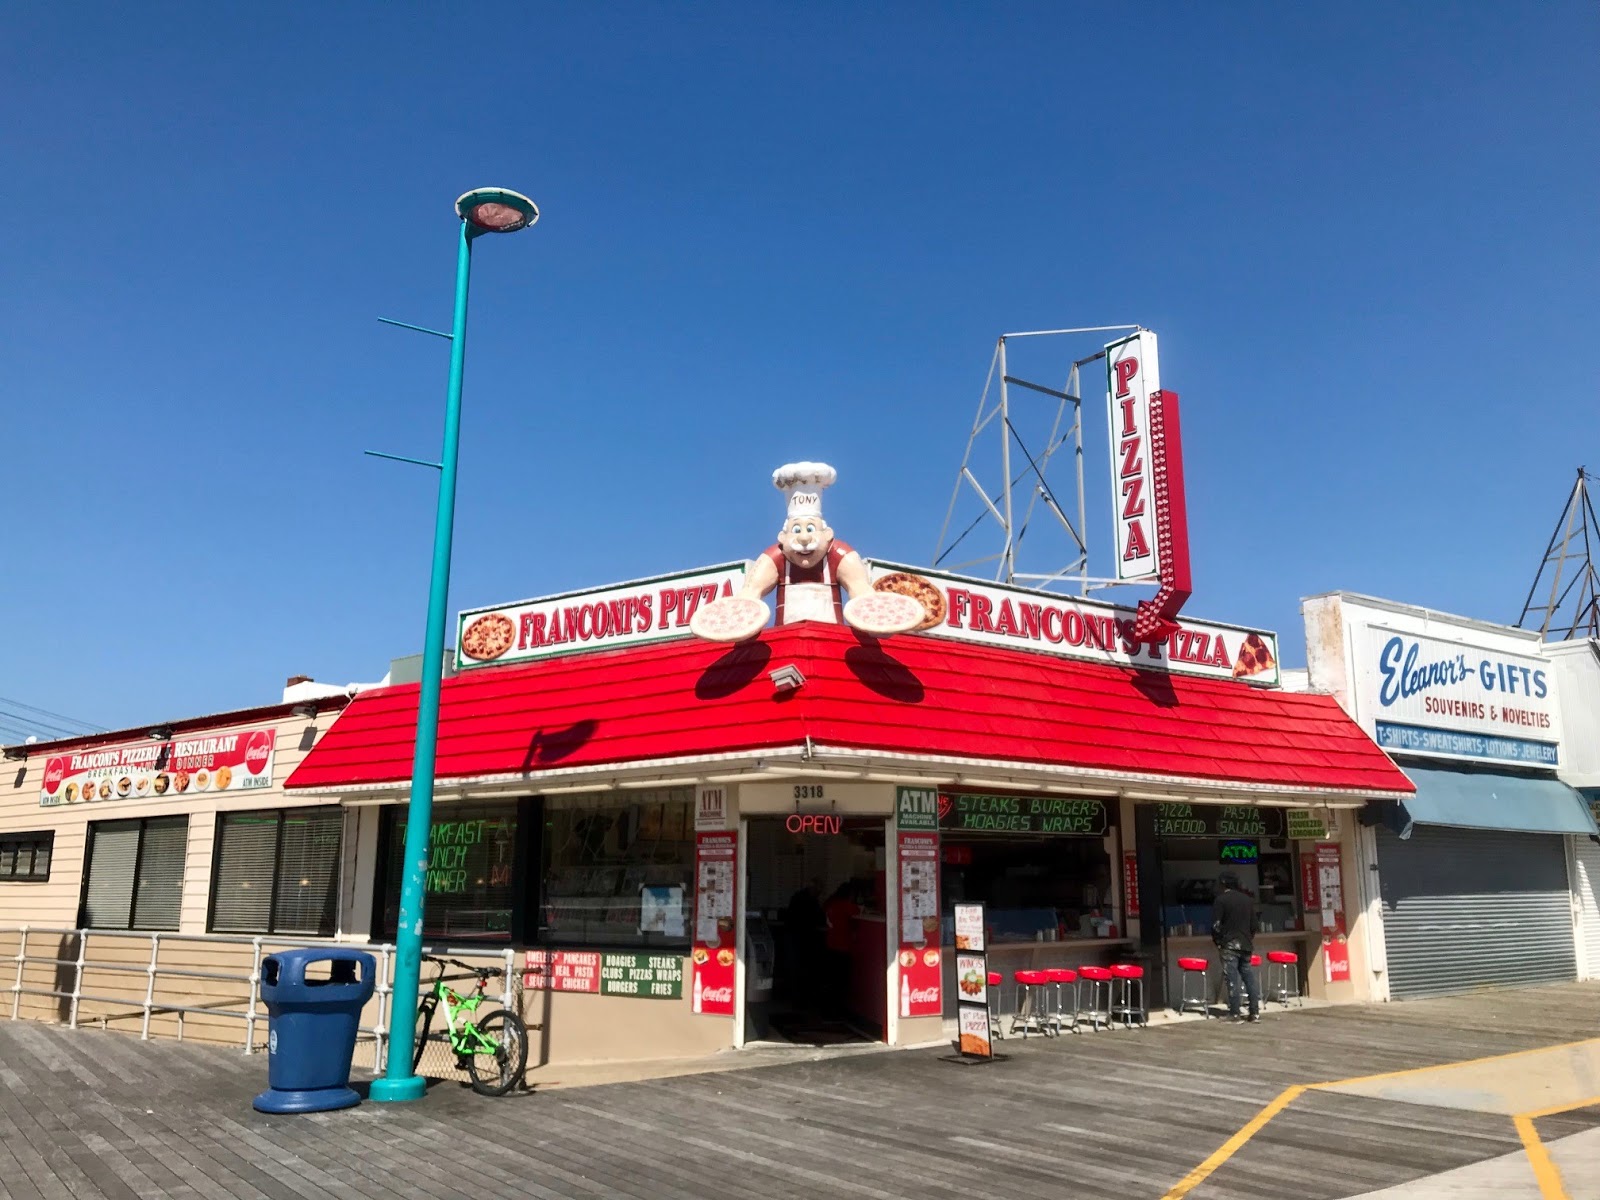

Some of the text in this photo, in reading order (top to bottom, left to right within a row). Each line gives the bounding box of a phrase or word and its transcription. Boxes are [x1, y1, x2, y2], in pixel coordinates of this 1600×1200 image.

[1115, 356, 1150, 561] PIZZA
[792, 495, 818, 505] TONY
[518, 594, 653, 650] FRANCONI'S
[945, 586, 1141, 656] FRANCONI'S
[1379, 636, 1548, 707] Eleanor's GIFTS
[1425, 696, 1550, 729] SOUVENIRS & NOVELTIES
[70, 750, 120, 771] FRANCONI'S
[121, 744, 162, 764] PIZZERIA
[174, 736, 238, 758] RESTAURANT
[87, 755, 214, 779] BREAKFAST LUNH DINNER
[700, 789, 722, 810] ATM
[794, 785, 823, 798] 3318
[900, 790, 935, 813] ATM
[957, 795, 1020, 814] STEAKS
[1031, 800, 1100, 816] BURGERS
[1157, 803, 1260, 821] PIZZA PASTA
[786, 814, 840, 835] OPEN
[963, 813, 1093, 832] HOAGIES WRAPS
[1219, 821, 1266, 835] SALADS
[427, 846, 467, 869] UNCH
[1221, 845, 1258, 859] ATM
[427, 870, 467, 893] INNER
[563, 952, 597, 966] PANCAKES
[606, 955, 676, 969] HOAGIES STEAKS
[960, 958, 983, 968] WINGS
[555, 965, 571, 977] VEAL
[574, 966, 594, 978] PASTA
[602, 968, 682, 982] CLUBS PIZZAS WRAPS
[562, 977, 590, 990] CHICKEN
[607, 981, 672, 995] BURGERS FRIES
